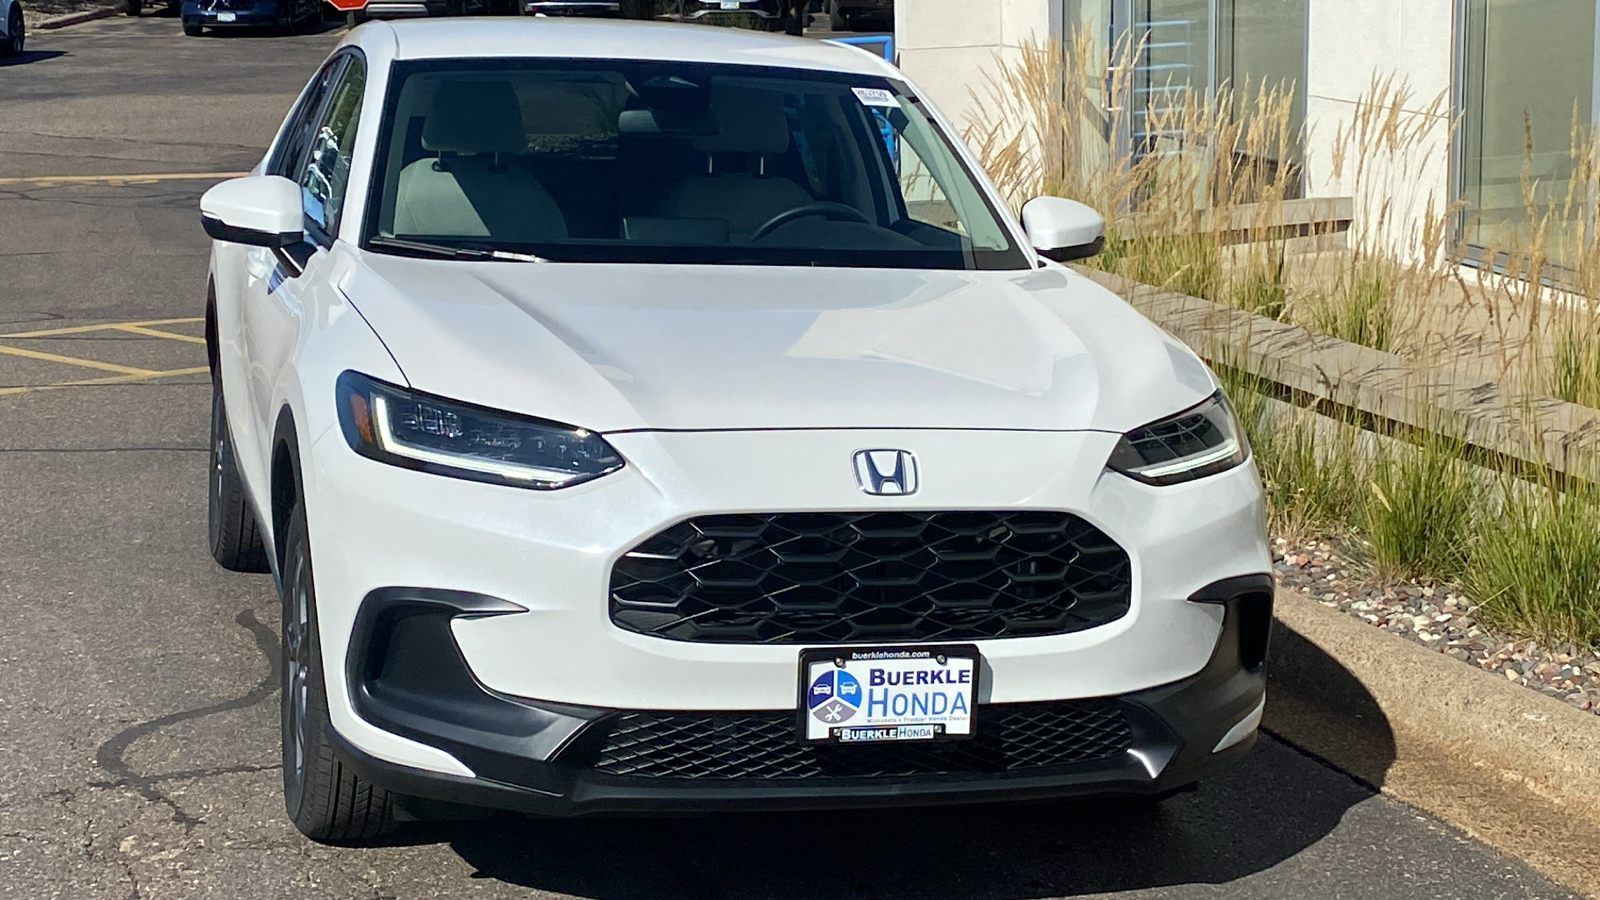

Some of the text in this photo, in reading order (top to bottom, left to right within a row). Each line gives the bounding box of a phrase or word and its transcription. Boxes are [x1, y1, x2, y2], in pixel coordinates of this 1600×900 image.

[851, 650, 930, 660] buerklehonda.com
[869, 668, 971, 687] BUERKLE
[867, 687, 968, 717] HONDA
